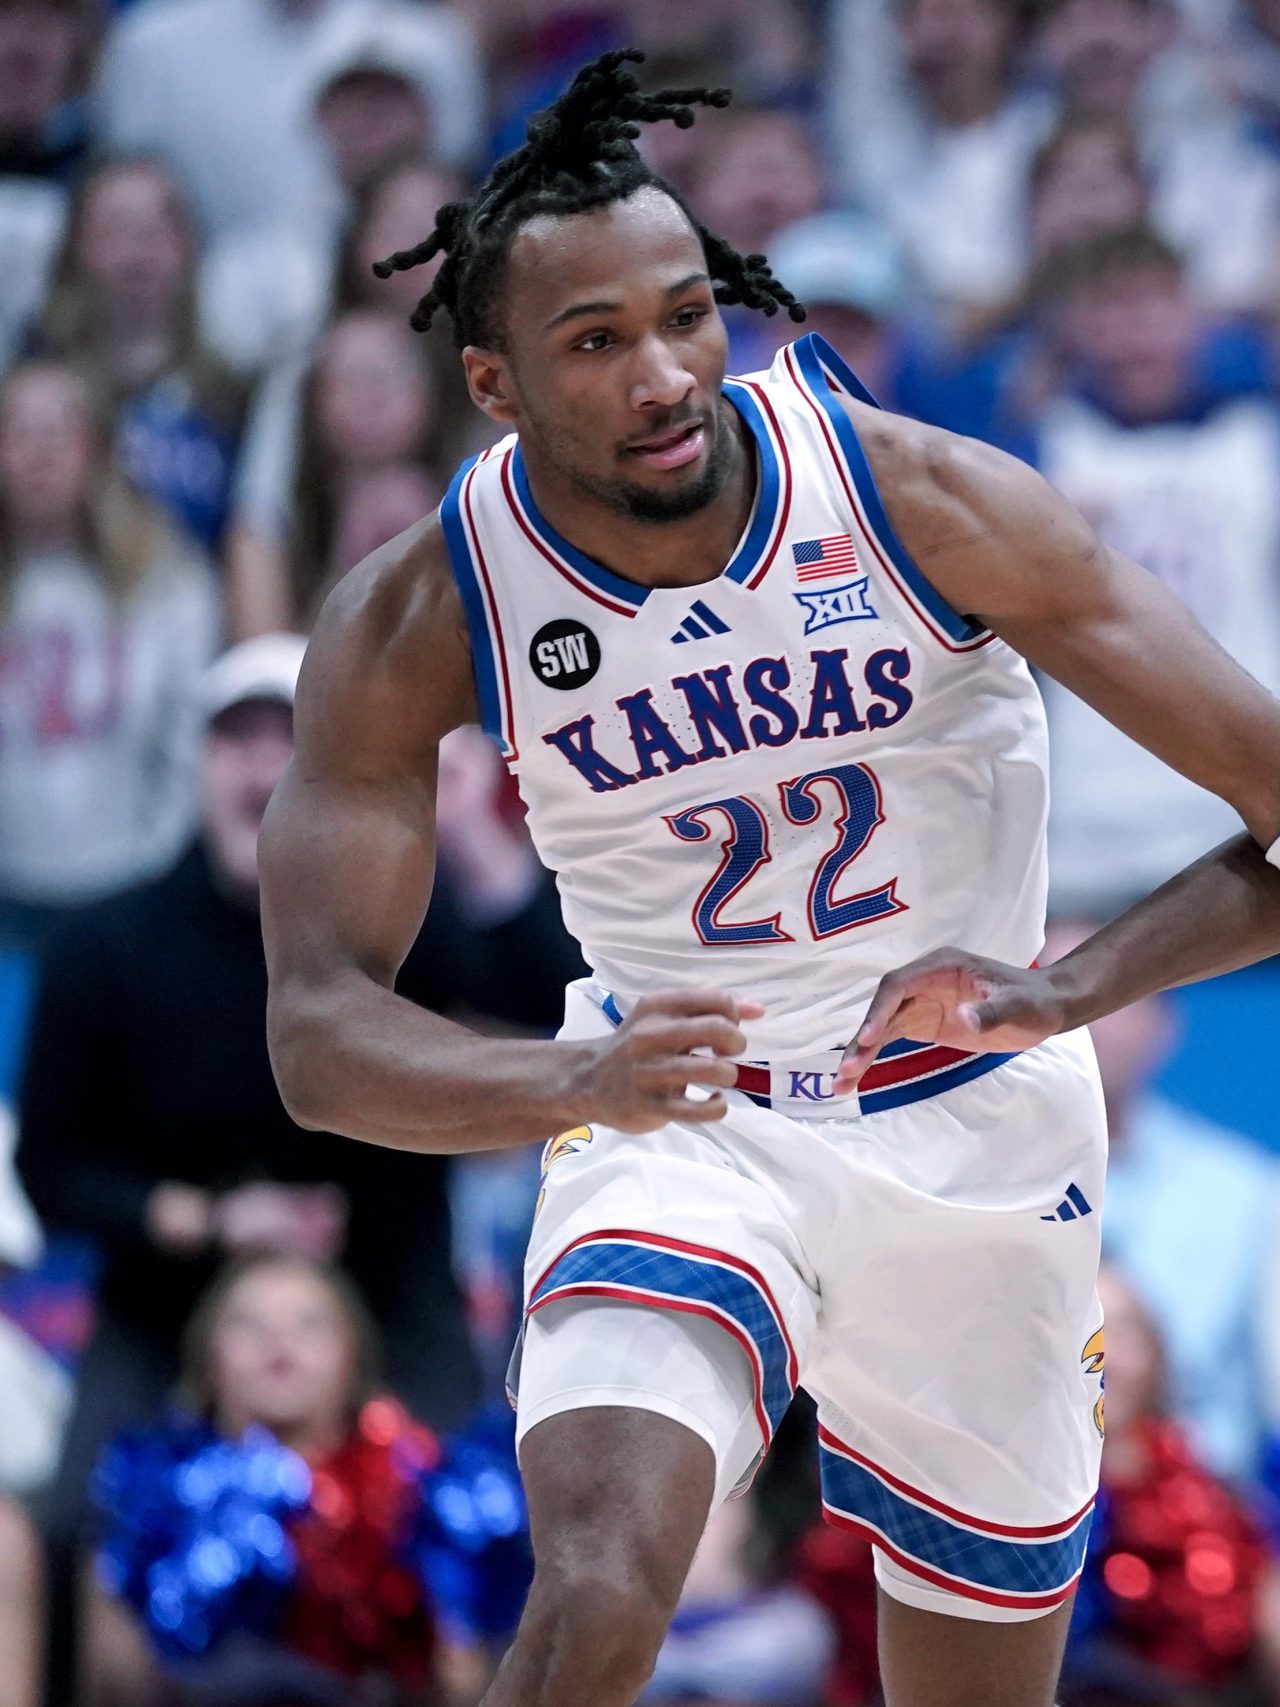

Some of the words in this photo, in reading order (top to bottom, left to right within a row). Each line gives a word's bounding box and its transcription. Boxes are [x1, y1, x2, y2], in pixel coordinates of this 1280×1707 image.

[536, 632, 590, 678] SW
[543, 648, 914, 792] KANSAS
[661, 762, 910, 946] 22
[788, 1071, 838, 1101] KU
